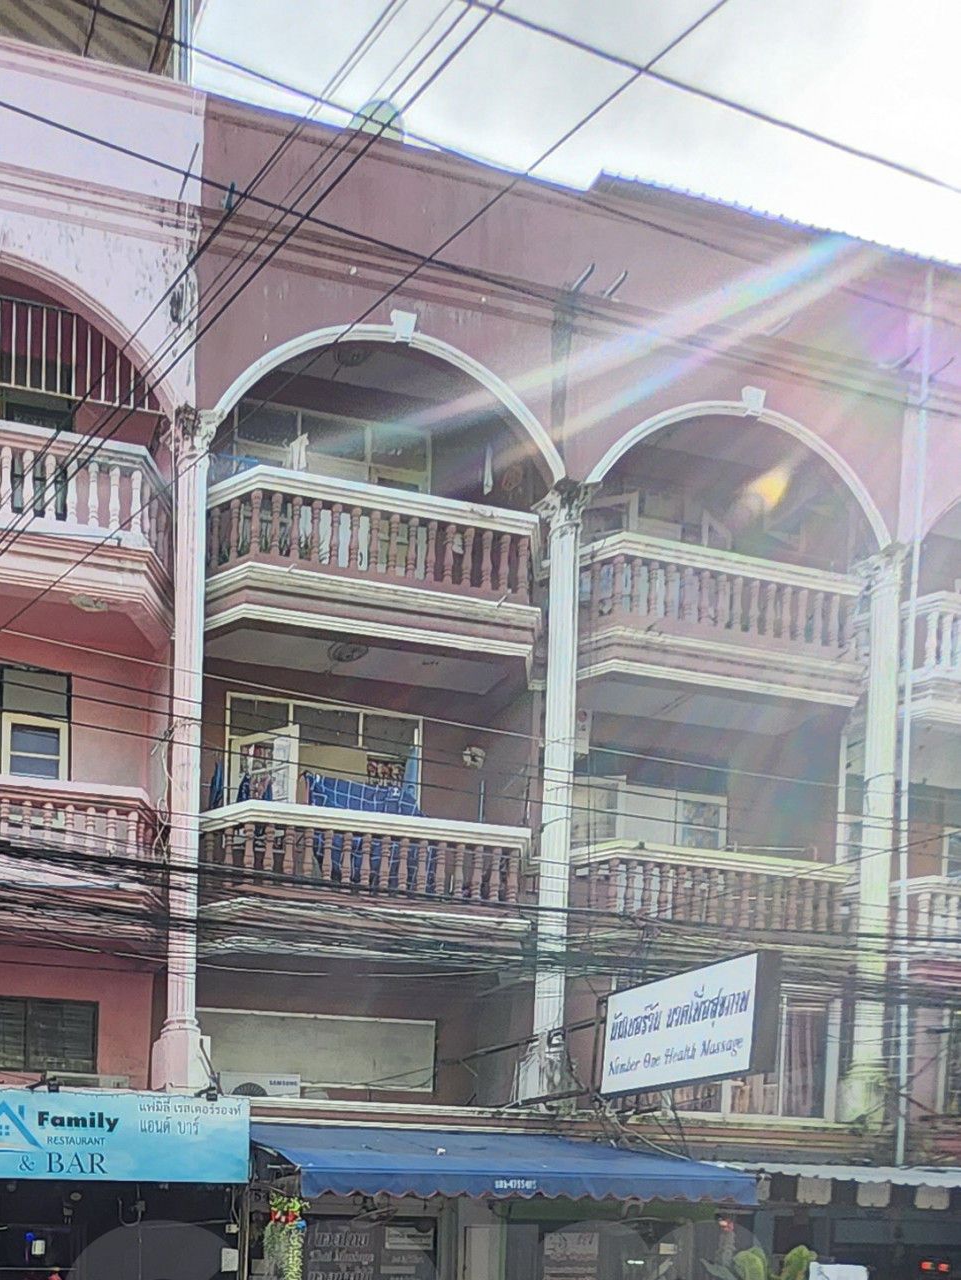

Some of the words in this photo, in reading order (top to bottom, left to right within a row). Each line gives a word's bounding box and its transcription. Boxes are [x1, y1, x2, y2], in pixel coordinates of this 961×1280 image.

[608, 1056, 640, 1077] Number
[643, 1053, 661, 1069] One
[665, 1044, 697, 1065] Health
[700, 1037, 744, 1058] Massage
[38, 1111, 119, 1133] Family
[178, 1116, 200, 1135] บาร์
[47, 1136, 105, 1146] RESTAURANT
[19, 1155, 35, 1171] &
[46, 1151, 109, 1174] BAR
